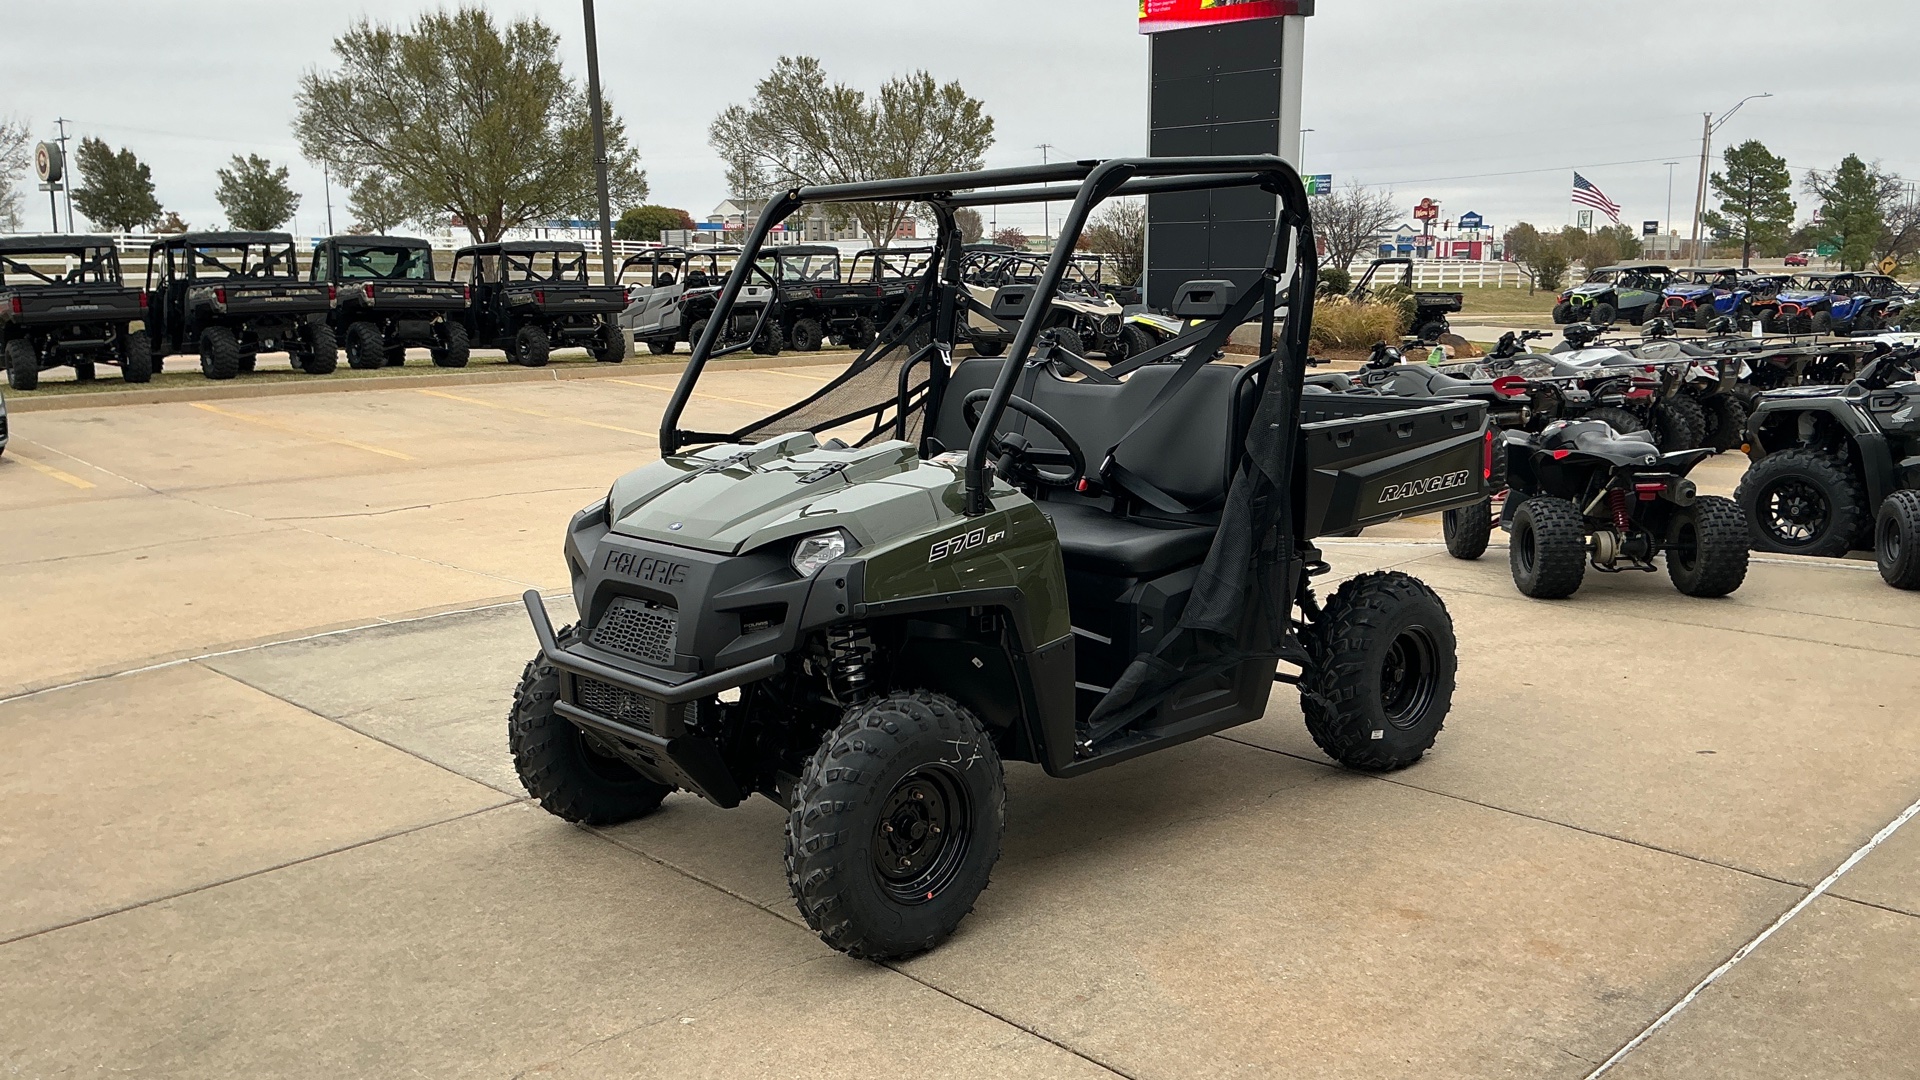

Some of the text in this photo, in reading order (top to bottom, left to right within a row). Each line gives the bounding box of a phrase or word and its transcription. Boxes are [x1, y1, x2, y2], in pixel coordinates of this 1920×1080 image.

[1378, 469, 1470, 504] RANGER
[928, 527, 1005, 563] 570 EFI
[603, 550, 691, 586] POLARIS
[743, 620, 769, 628] POLARIS
